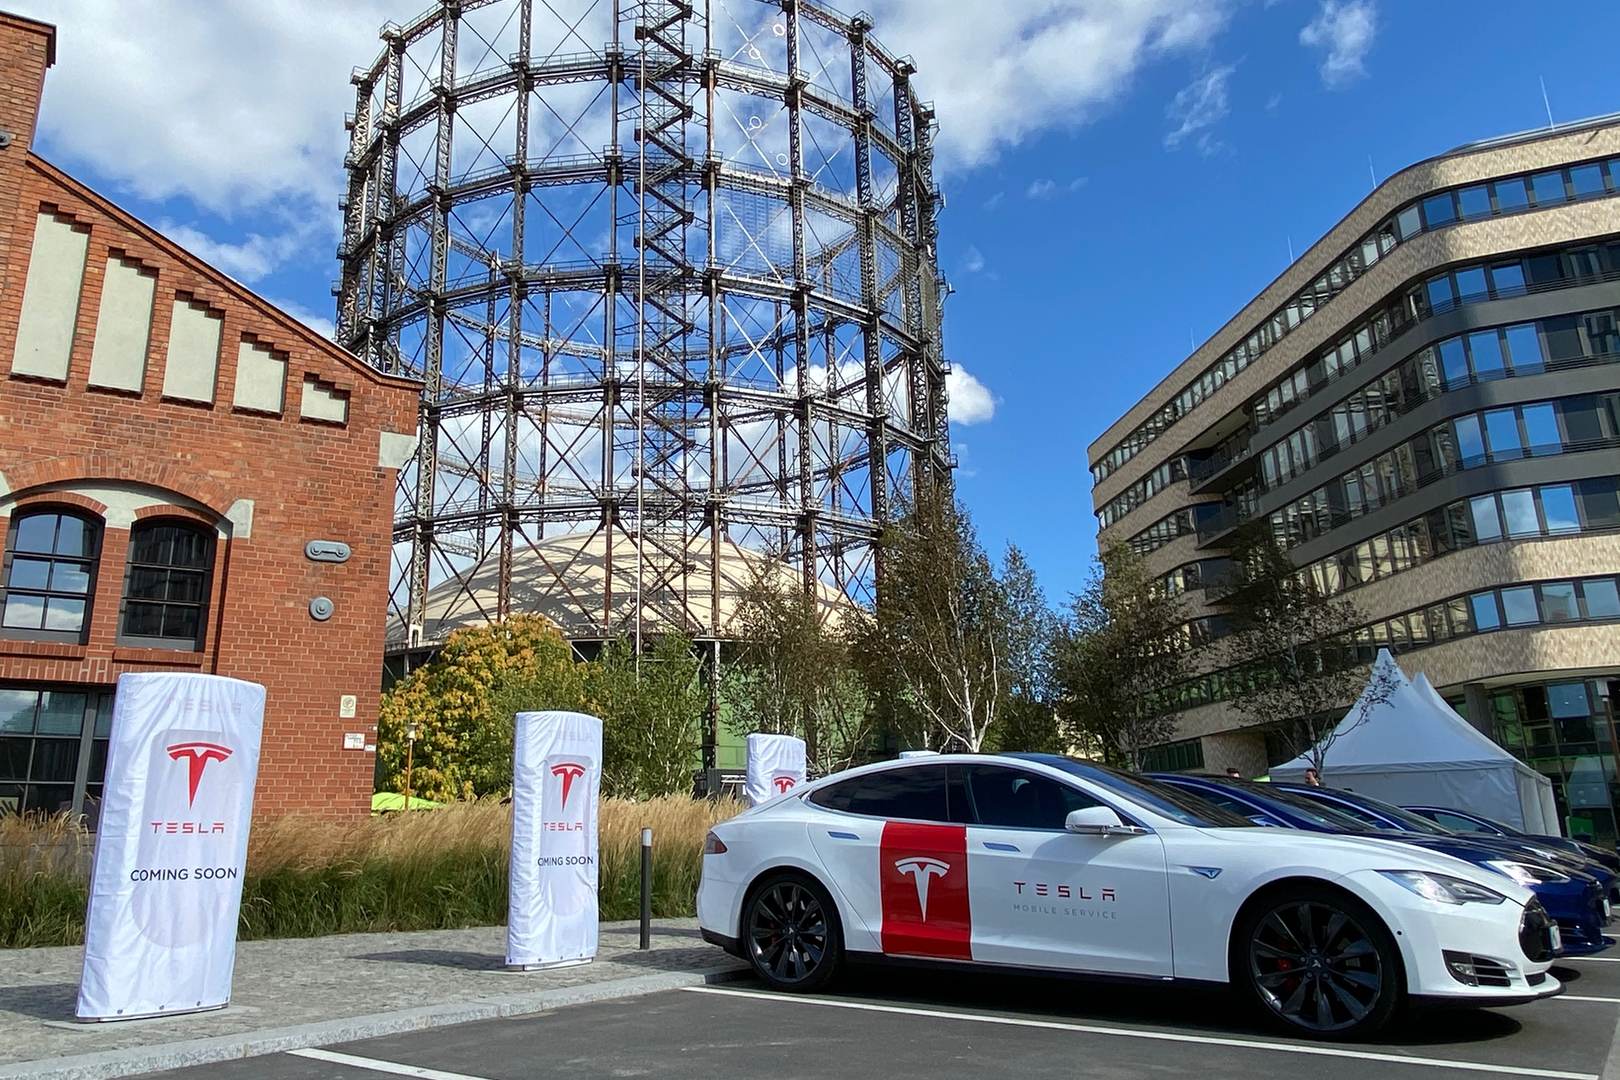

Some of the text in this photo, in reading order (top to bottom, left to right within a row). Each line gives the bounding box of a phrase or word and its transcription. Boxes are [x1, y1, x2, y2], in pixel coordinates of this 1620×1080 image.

[151, 821, 225, 834] TESLA
[543, 822, 583, 832] TESLA
[565, 856, 594, 866] SOON
[130, 867, 238, 882] COMING SOON
[1013, 881, 1116, 902] TESLA
[1013, 903, 1118, 920] MOBILE SERVICE
